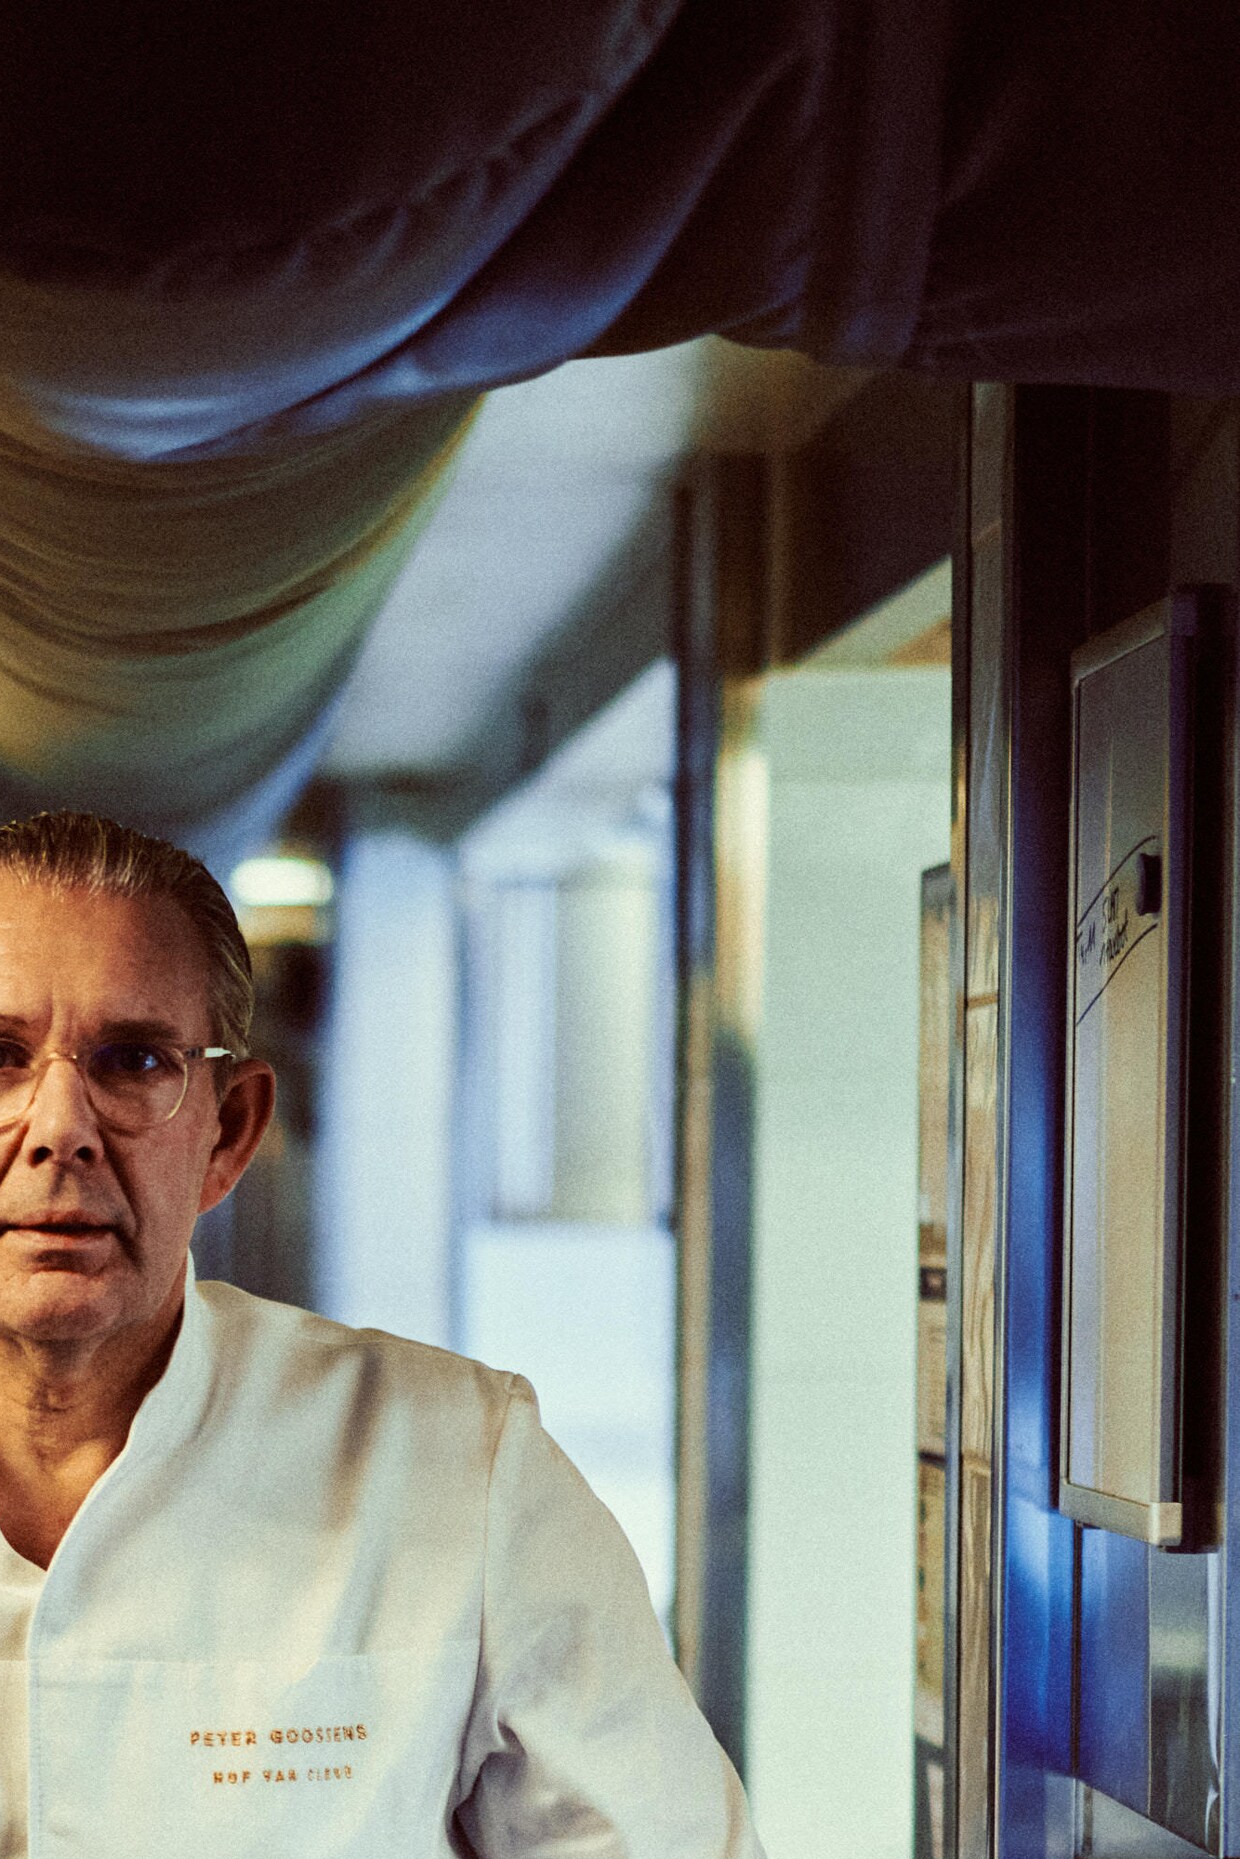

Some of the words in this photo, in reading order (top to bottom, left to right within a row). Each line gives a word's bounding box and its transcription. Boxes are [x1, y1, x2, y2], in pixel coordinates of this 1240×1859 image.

[190, 1729, 257, 1747] PETER
[269, 1724, 367, 1744] GOOSSENS
[212, 1769, 251, 1784] HOF
